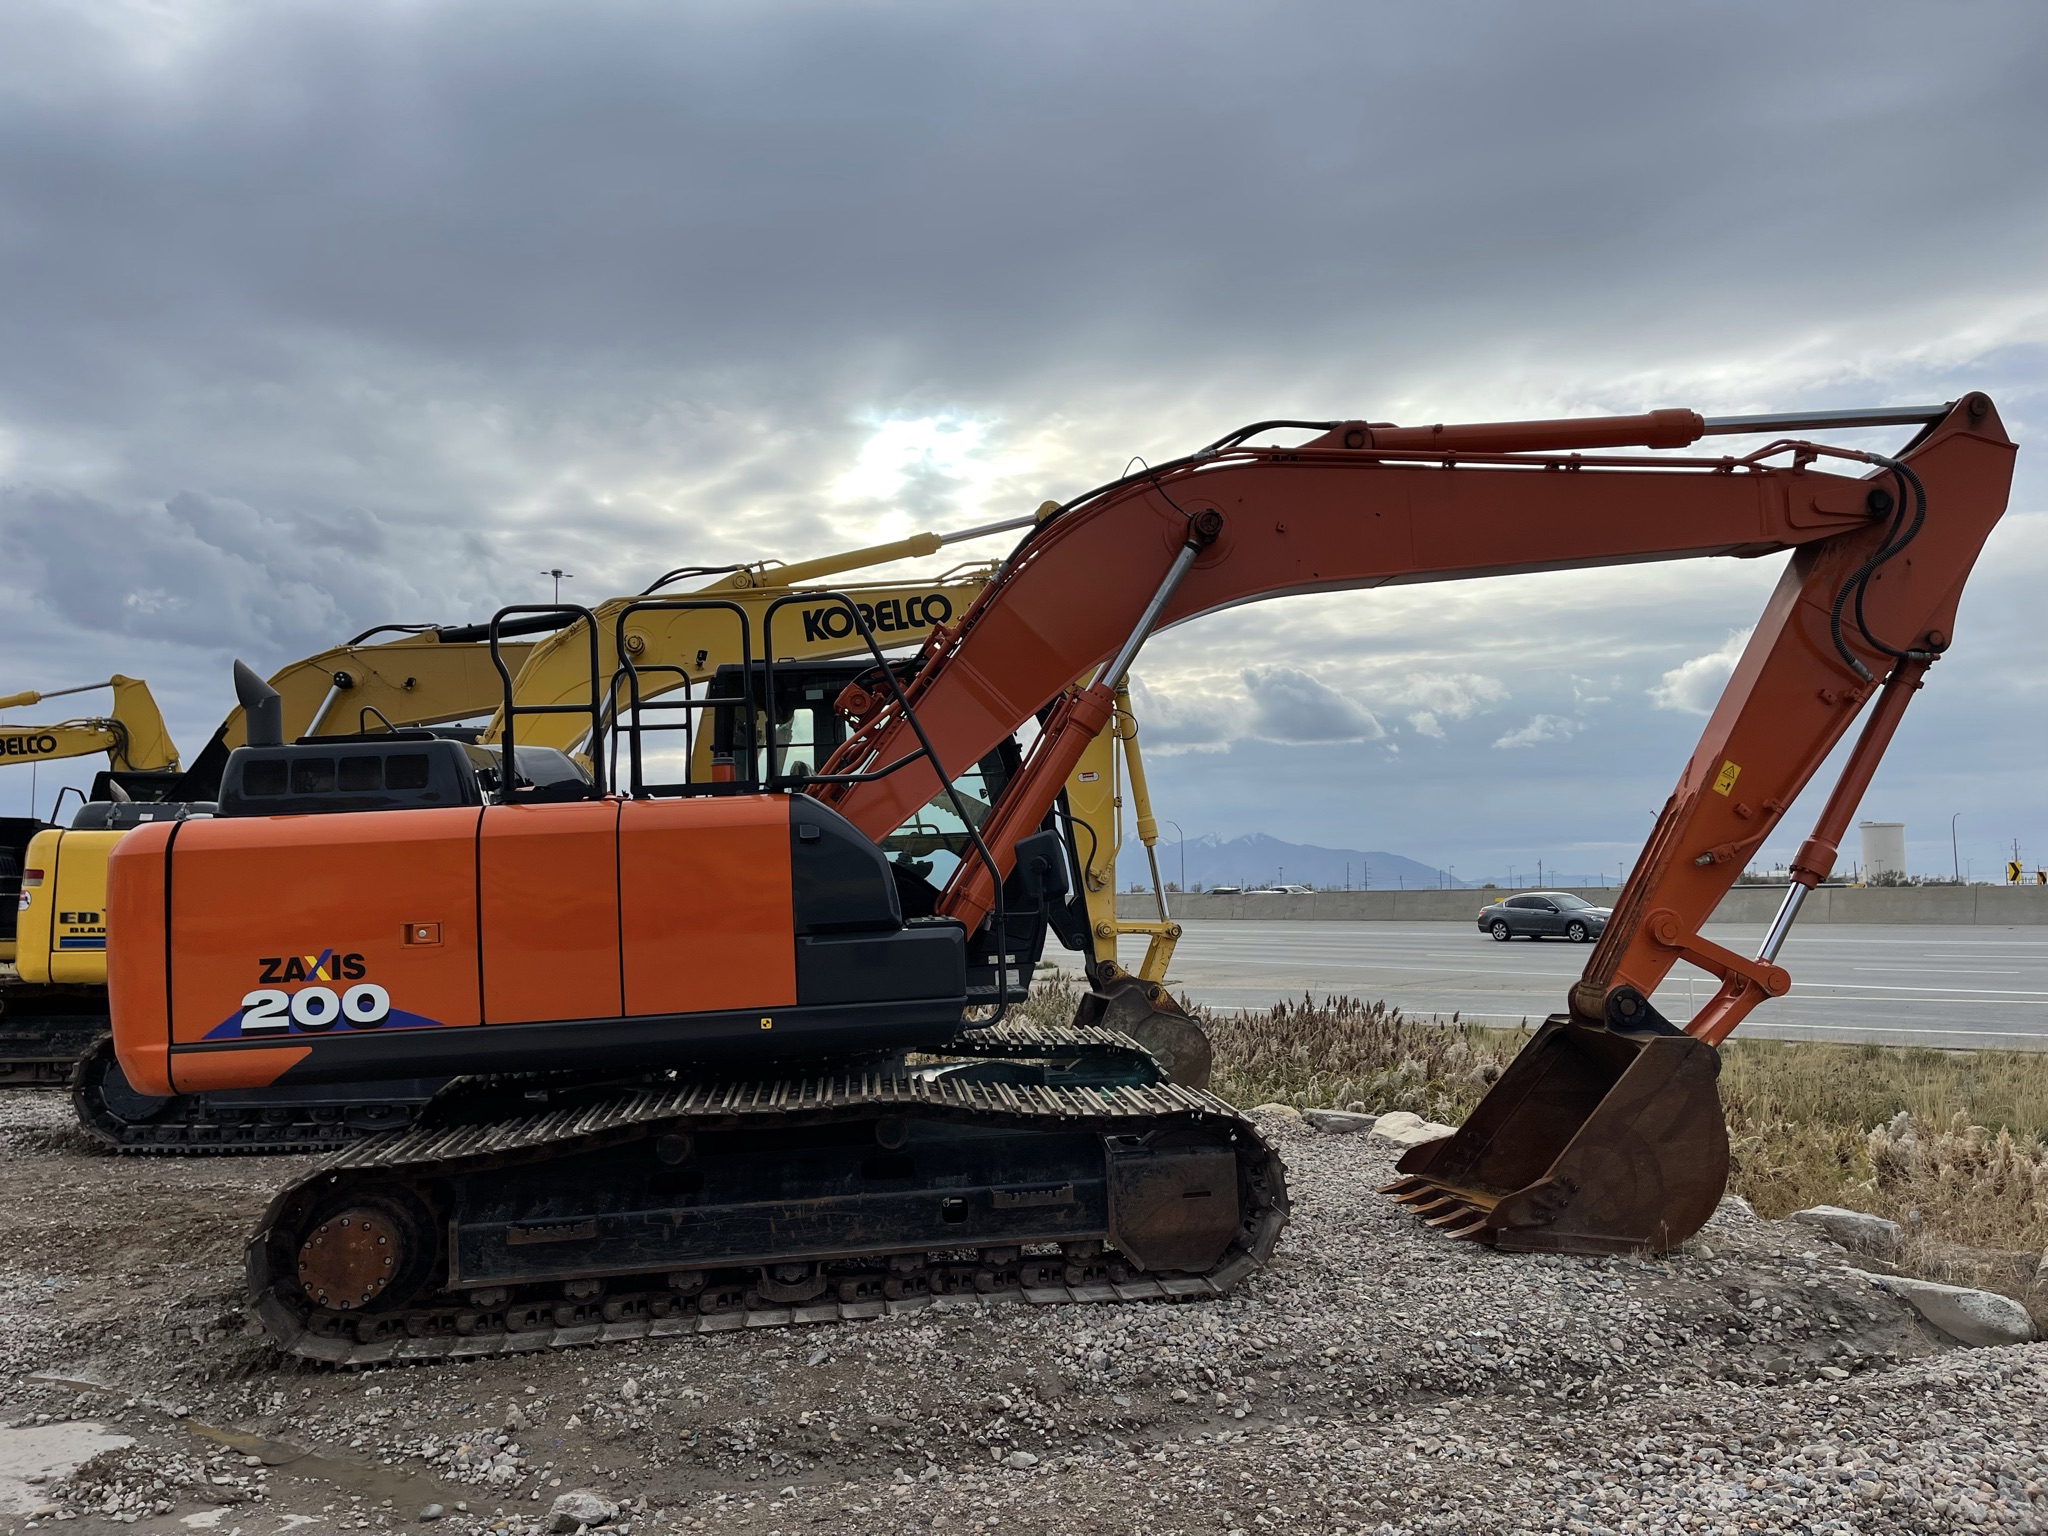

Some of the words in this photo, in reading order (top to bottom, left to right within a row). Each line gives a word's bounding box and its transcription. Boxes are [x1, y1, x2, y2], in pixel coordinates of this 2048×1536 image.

[803, 594, 952, 642] KOBELCO
[60, 908, 106, 924] ED
[259, 949, 366, 984] ZAXIS
[241, 984, 390, 1037] 200
